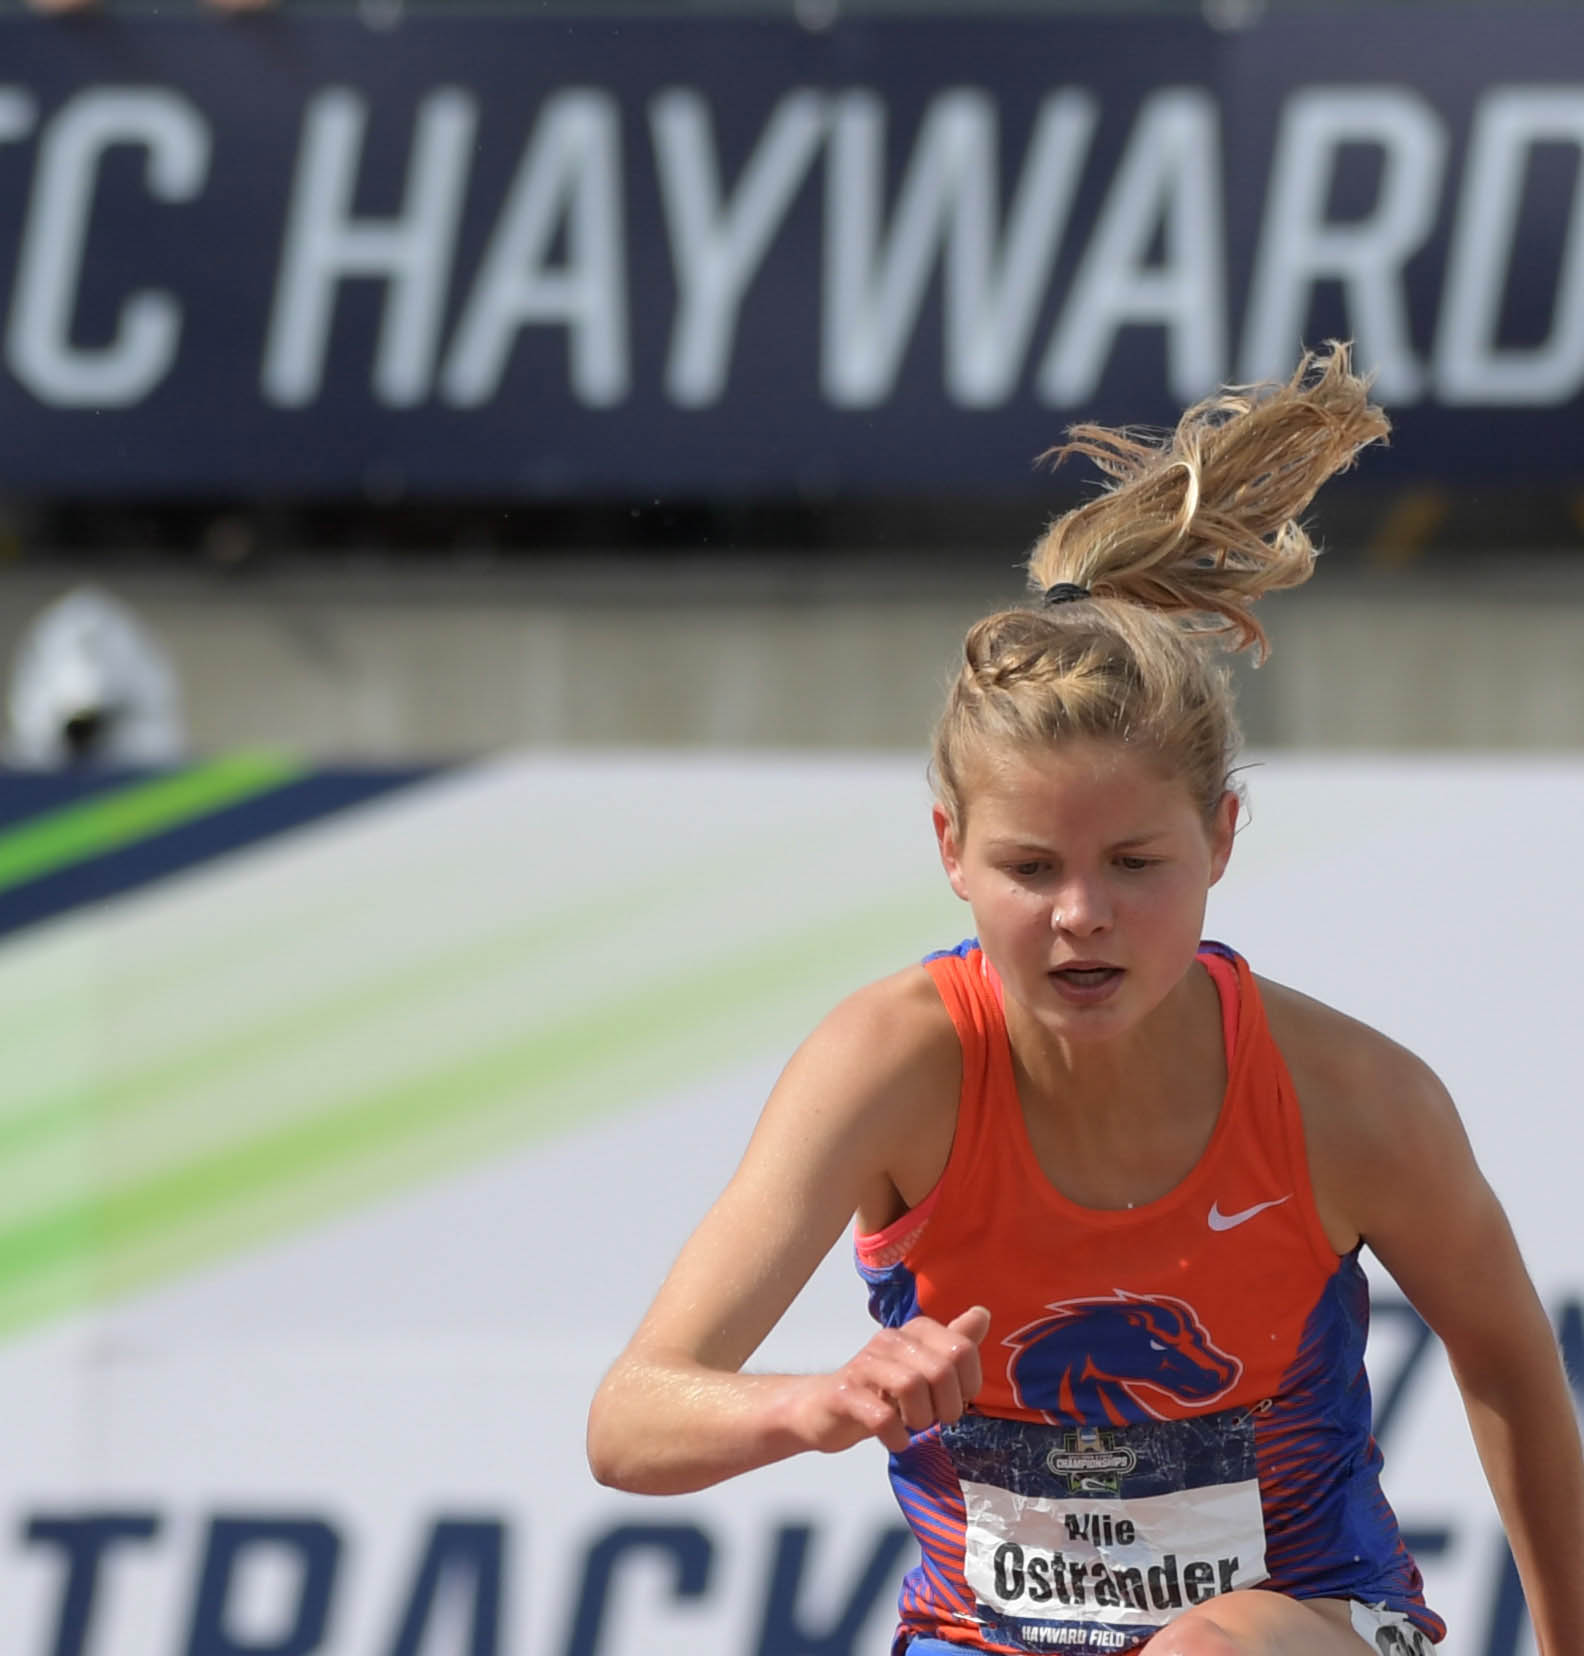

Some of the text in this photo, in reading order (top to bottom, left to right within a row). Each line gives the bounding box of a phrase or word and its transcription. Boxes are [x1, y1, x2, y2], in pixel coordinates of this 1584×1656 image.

[993, 1541, 1240, 1612] Ostrander
[1022, 1625, 1126, 1648] HAYWARD FIELD
